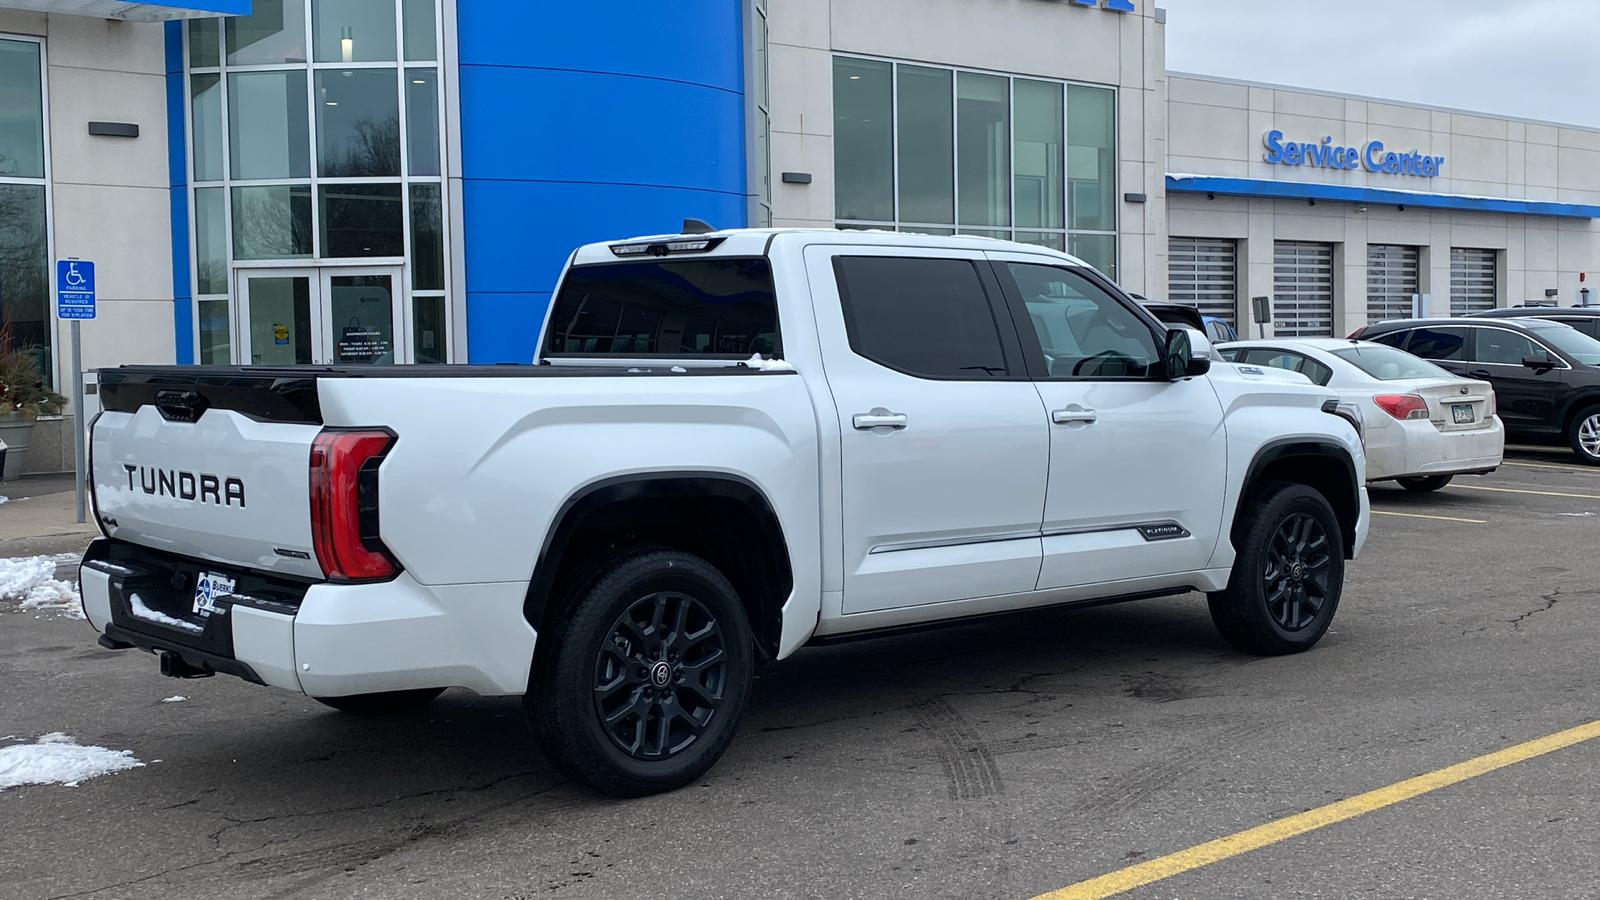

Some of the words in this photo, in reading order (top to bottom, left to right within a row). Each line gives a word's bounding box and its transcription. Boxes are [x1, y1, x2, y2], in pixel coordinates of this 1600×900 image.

[1263, 130, 1359, 169] Service
[1362, 140, 1444, 177] Center
[123, 463, 246, 508] TUNDRA
